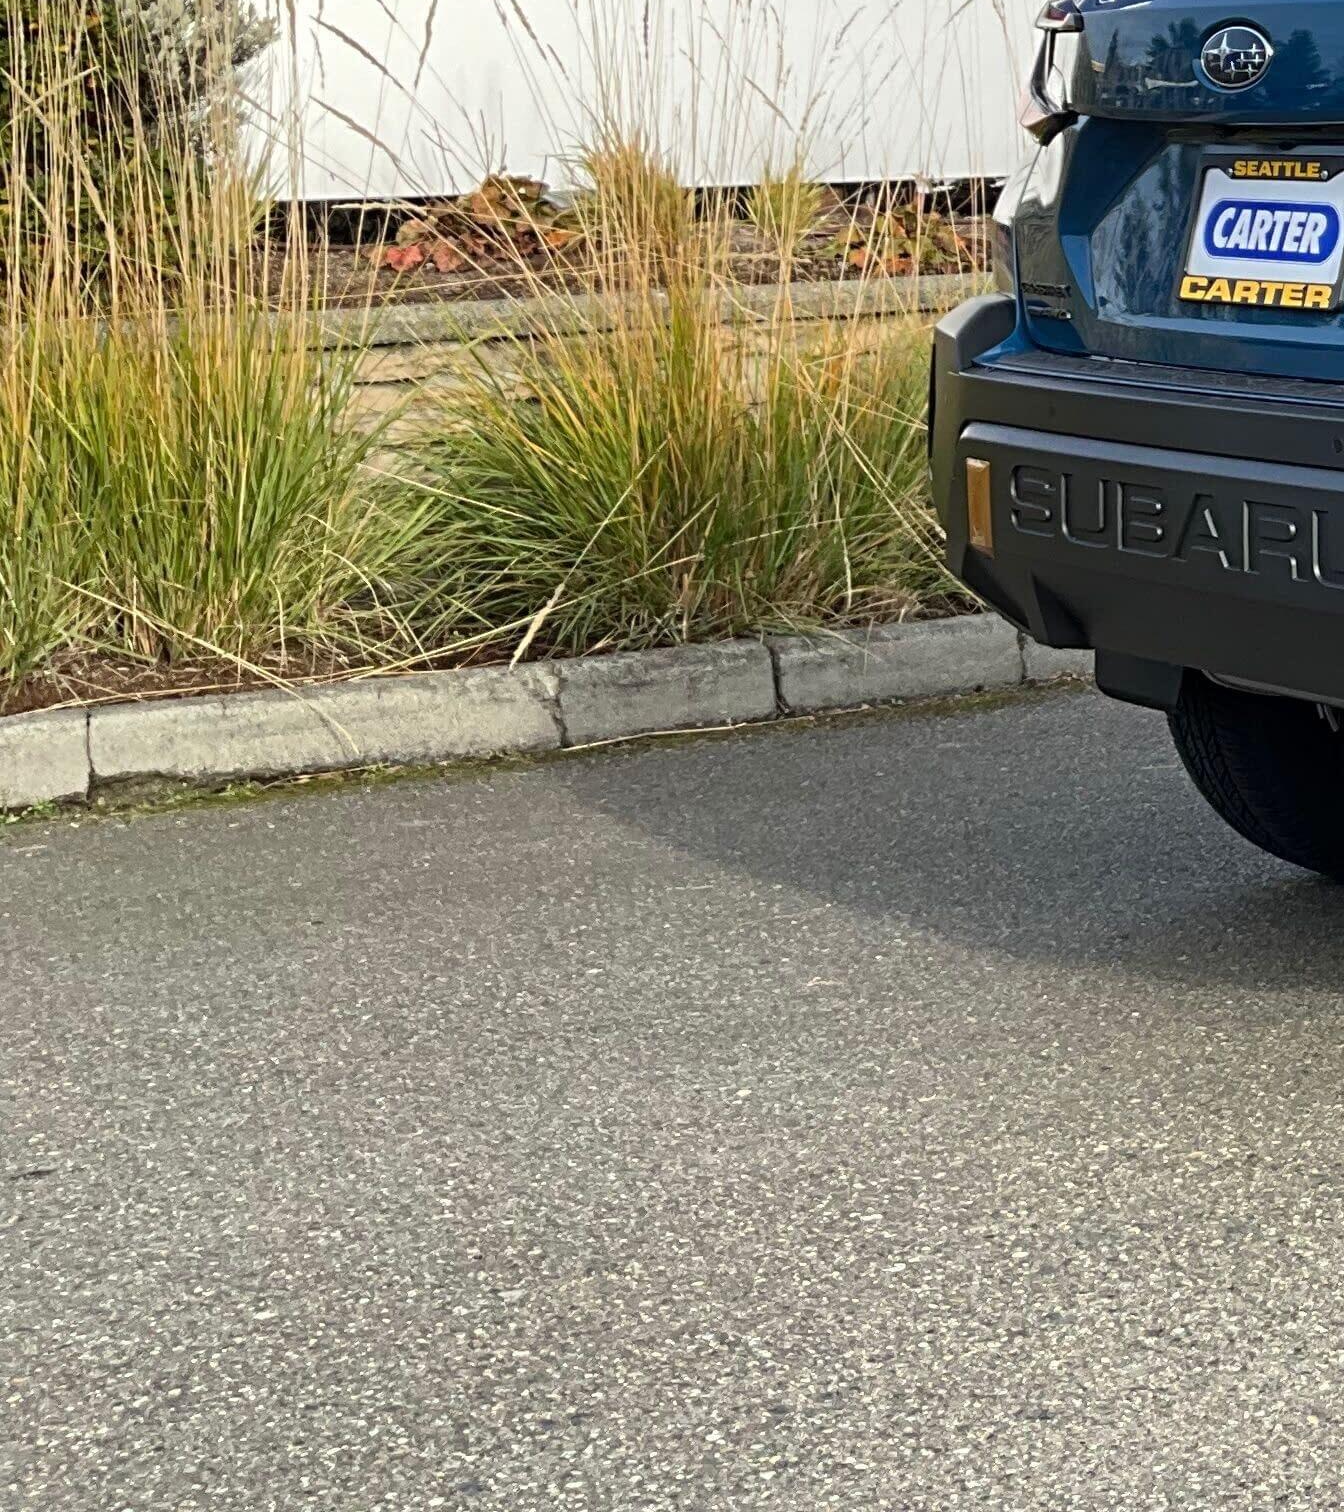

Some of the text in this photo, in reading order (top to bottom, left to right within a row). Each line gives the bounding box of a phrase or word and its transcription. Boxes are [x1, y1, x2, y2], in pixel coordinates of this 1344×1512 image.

[1233, 160, 1321, 178] SEATTLE
[1213, 207, 1327, 254] CARTER
[1180, 276, 1332, 309] CARTER
